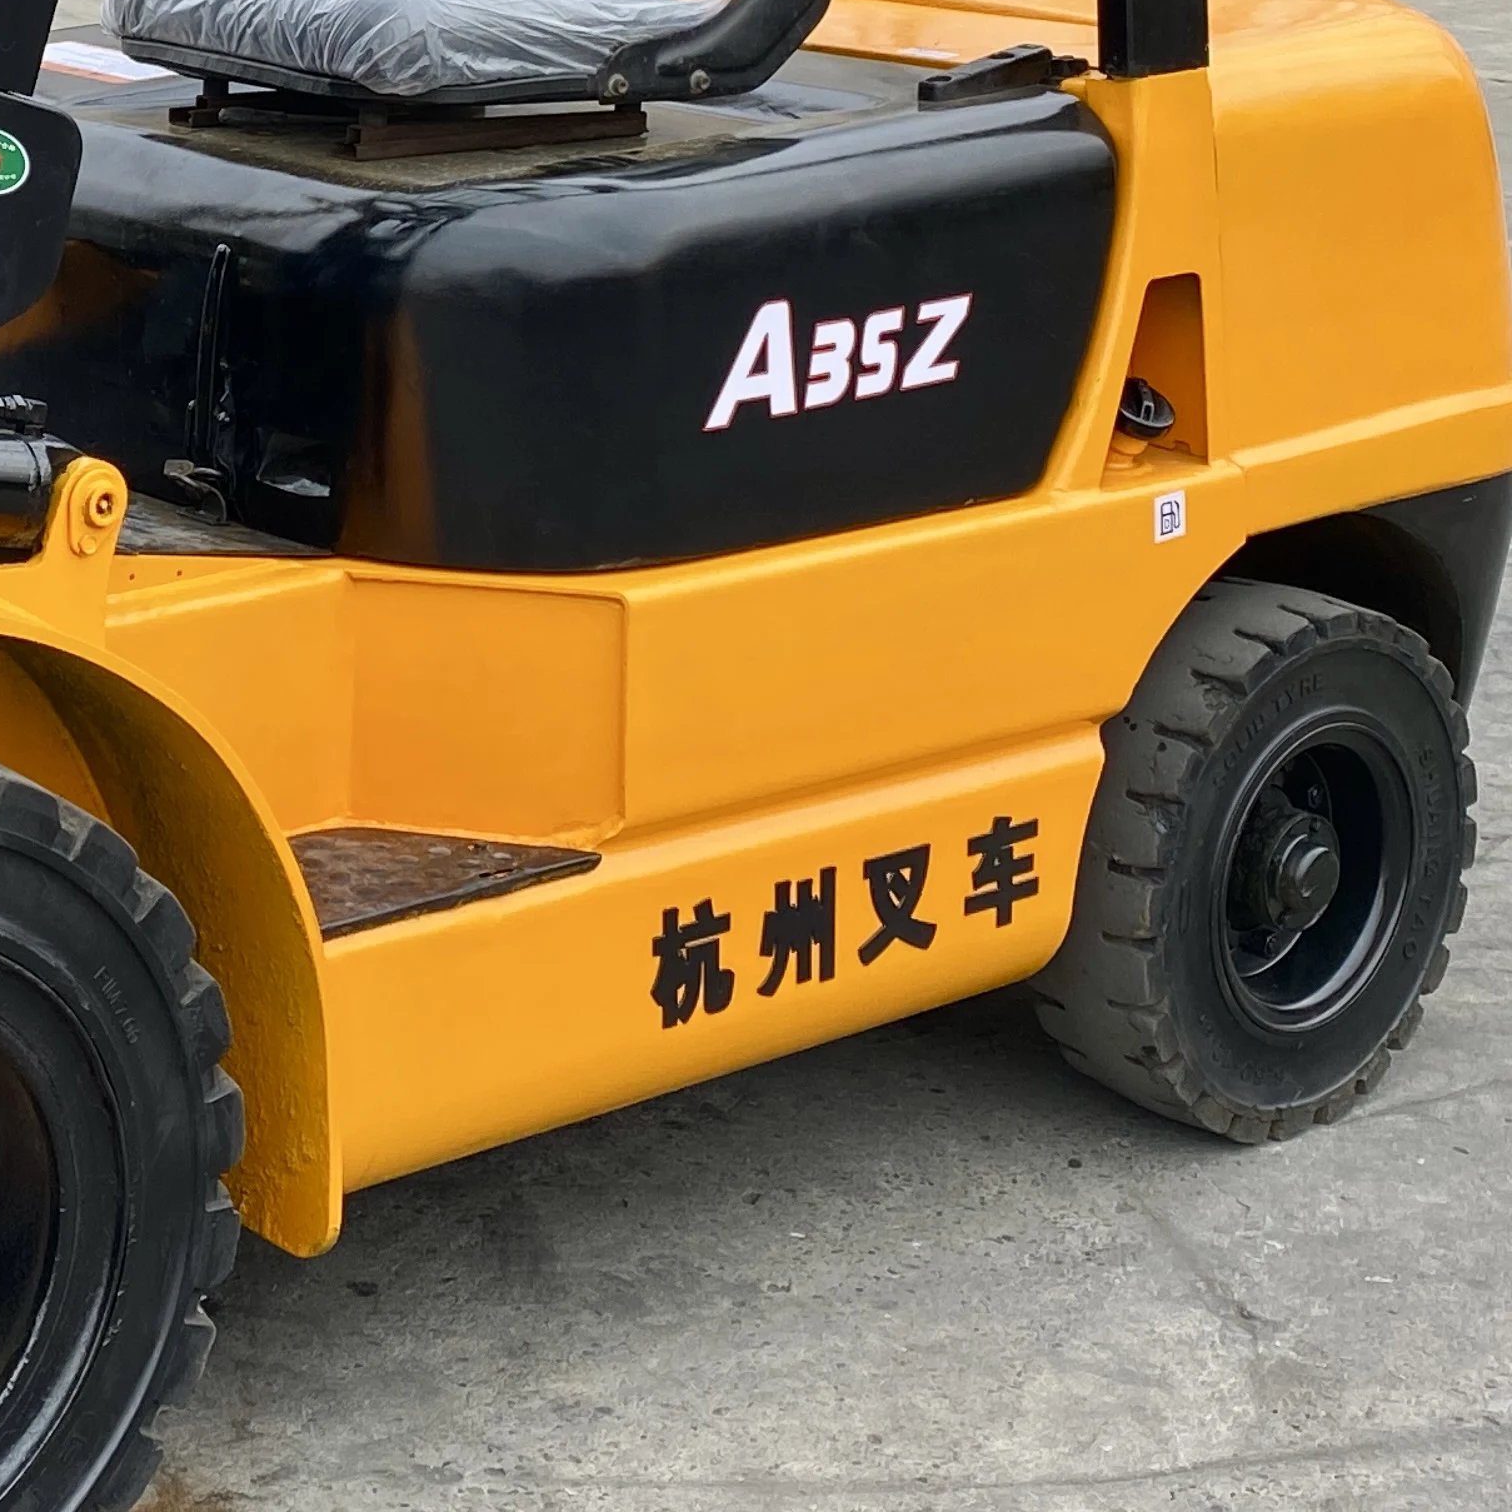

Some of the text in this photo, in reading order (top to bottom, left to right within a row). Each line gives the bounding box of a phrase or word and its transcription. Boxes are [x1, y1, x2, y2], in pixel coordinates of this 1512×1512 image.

[702, 292, 973, 431] A35Z
[1271, 671, 1326, 713] TYRE
[650, 816, 1039, 1029] 杭州叉车
